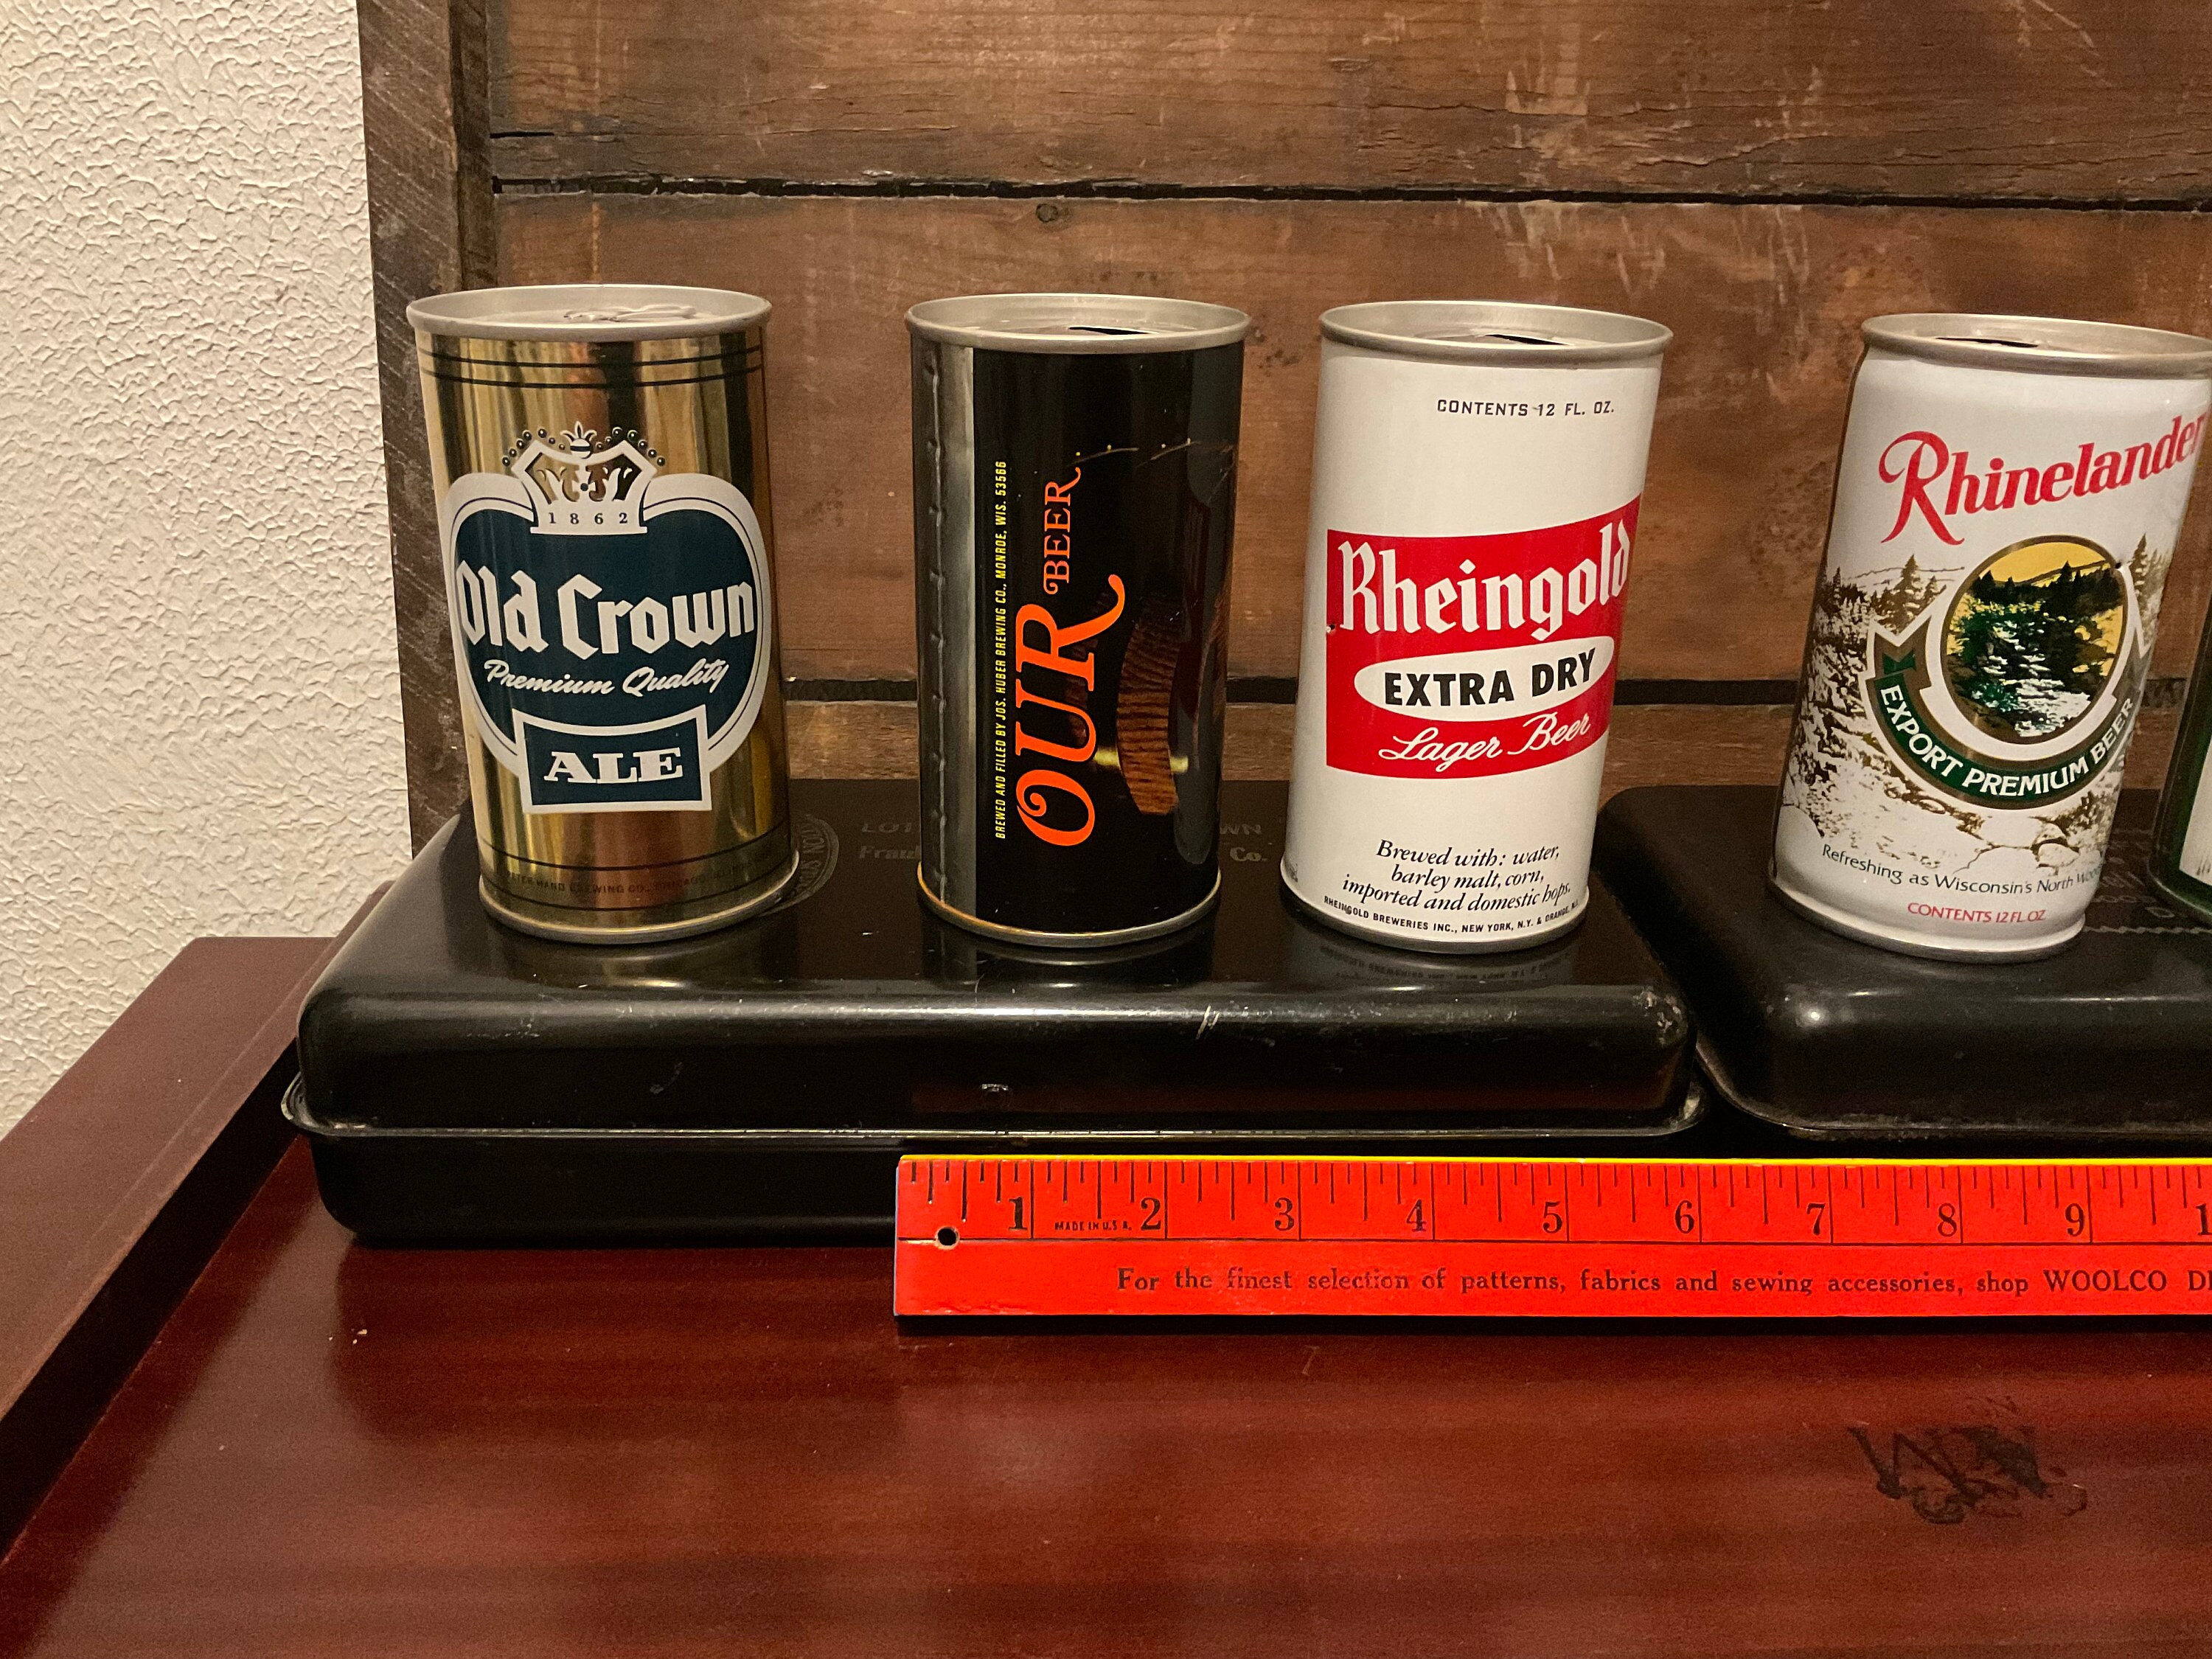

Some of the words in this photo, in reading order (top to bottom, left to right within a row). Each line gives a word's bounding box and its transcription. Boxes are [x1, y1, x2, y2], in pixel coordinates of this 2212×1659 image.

[1437, 399, 1528, 417] CONTENTS
[1536, 403, 1555, 417] 12
[1565, 402, 1586, 416] FL.
[1593, 400, 1615, 415] OZ.
[995, 461, 1007, 496] 53566
[1878, 411, 2207, 546] Rhinelander
[548, 512, 629, 524] 1862
[995, 501, 1006, 526] WIS.
[1043, 467, 1082, 595] BEER
[995, 530, 1007, 580] MONROE,
[995, 583, 1007, 604] CO.,
[1338, 519, 1631, 641] Rheingold
[455, 560, 549, 653] Old
[557, 574, 755, 660] Crown
[995, 608, 1006, 656] BREWING
[484, 659, 614, 695] Premium
[622, 658, 730, 698] Quality
[995, 659, 1006, 694] HUBER
[1385, 669, 1514, 707] EXTRA
[1531, 647, 1596, 697] DRY
[995, 698, 1006, 721] JOS.
[1015, 574, 1125, 846] OUR
[995, 723, 1006, 737] BY
[1378, 727, 1504, 773] Lager
[1507, 712, 1590, 757] Beer
[1880, 684, 1964, 778] EXPORT
[1962, 755, 2090, 797] PREMIUM
[2090, 698, 2134, 765] BEER
[544, 747, 683, 785] ALE
[995, 740, 1006, 772] FILLED
[995, 776, 1006, 796] AND
[995, 799, 1006, 839] BREWED
[1376, 839, 1453, 866] Brewed
[1455, 848, 1506, 867] with:
[1512, 845, 1560, 866] water,
[1821, 844, 1903, 884] Refreshing
[1909, 874, 1929, 886] as
[1935, 874, 2034, 895] Wisconsin's
[2036, 875, 2073, 892] North
[1343, 874, 1421, 907] imported
[1424, 892, 1466, 911] and
[1467, 888, 1540, 911] domestic
[1542, 883, 1571, 906] hops.
[1391, 864, 1450, 894] barley
[1454, 872, 1501, 891] malt,
[1505, 869, 1544, 886] corn,
[1324, 896, 1368, 919] RHEINGOLD
[1373, 913, 1429, 931] BREWERIES
[1433, 923, 1457, 933] INC.,
[1461, 922, 1484, 932] NEW
[1487, 922, 1513, 932] YORK,
[1517, 919, 1533, 928] N.Y.
[1907, 902, 1992, 923] CONTENTS
[1008, 1197, 1028, 1231] 1
[1141, 1197, 1161, 1231] 2
[1274, 1197, 1295, 1231] 3
[1405, 1199, 1426, 1232] 4
[1543, 1201, 1562, 1234] 5
[1674, 1200, 1695, 1234] 6
[1806, 1203, 1826, 1236] 7
[1937, 1203, 1958, 1237] 8
[2065, 1203, 2085, 1237] 9
[1054, 1221, 1085, 1231] MADE
[1088, 1221, 1099, 1231] IN
[1117, 1267, 1159, 1290] For
[1175, 1267, 1212, 1290] the
[1227, 1267, 1292, 1290] finest
[1308, 1267, 1409, 1291] selection
[1422, 1267, 1446, 1290] of
[1461, 1272, 1566, 1294] patterns,
[1580, 1268, 1660, 1292] fabrics
[1676, 1270, 1717, 1292] and
[1732, 1270, 1812, 1295] sewing
[1827, 1270, 1963, 1295] accessories,
[1977, 1270, 2028, 1297] shop
[2043, 1269, 2168, 1292] WOOLCO
